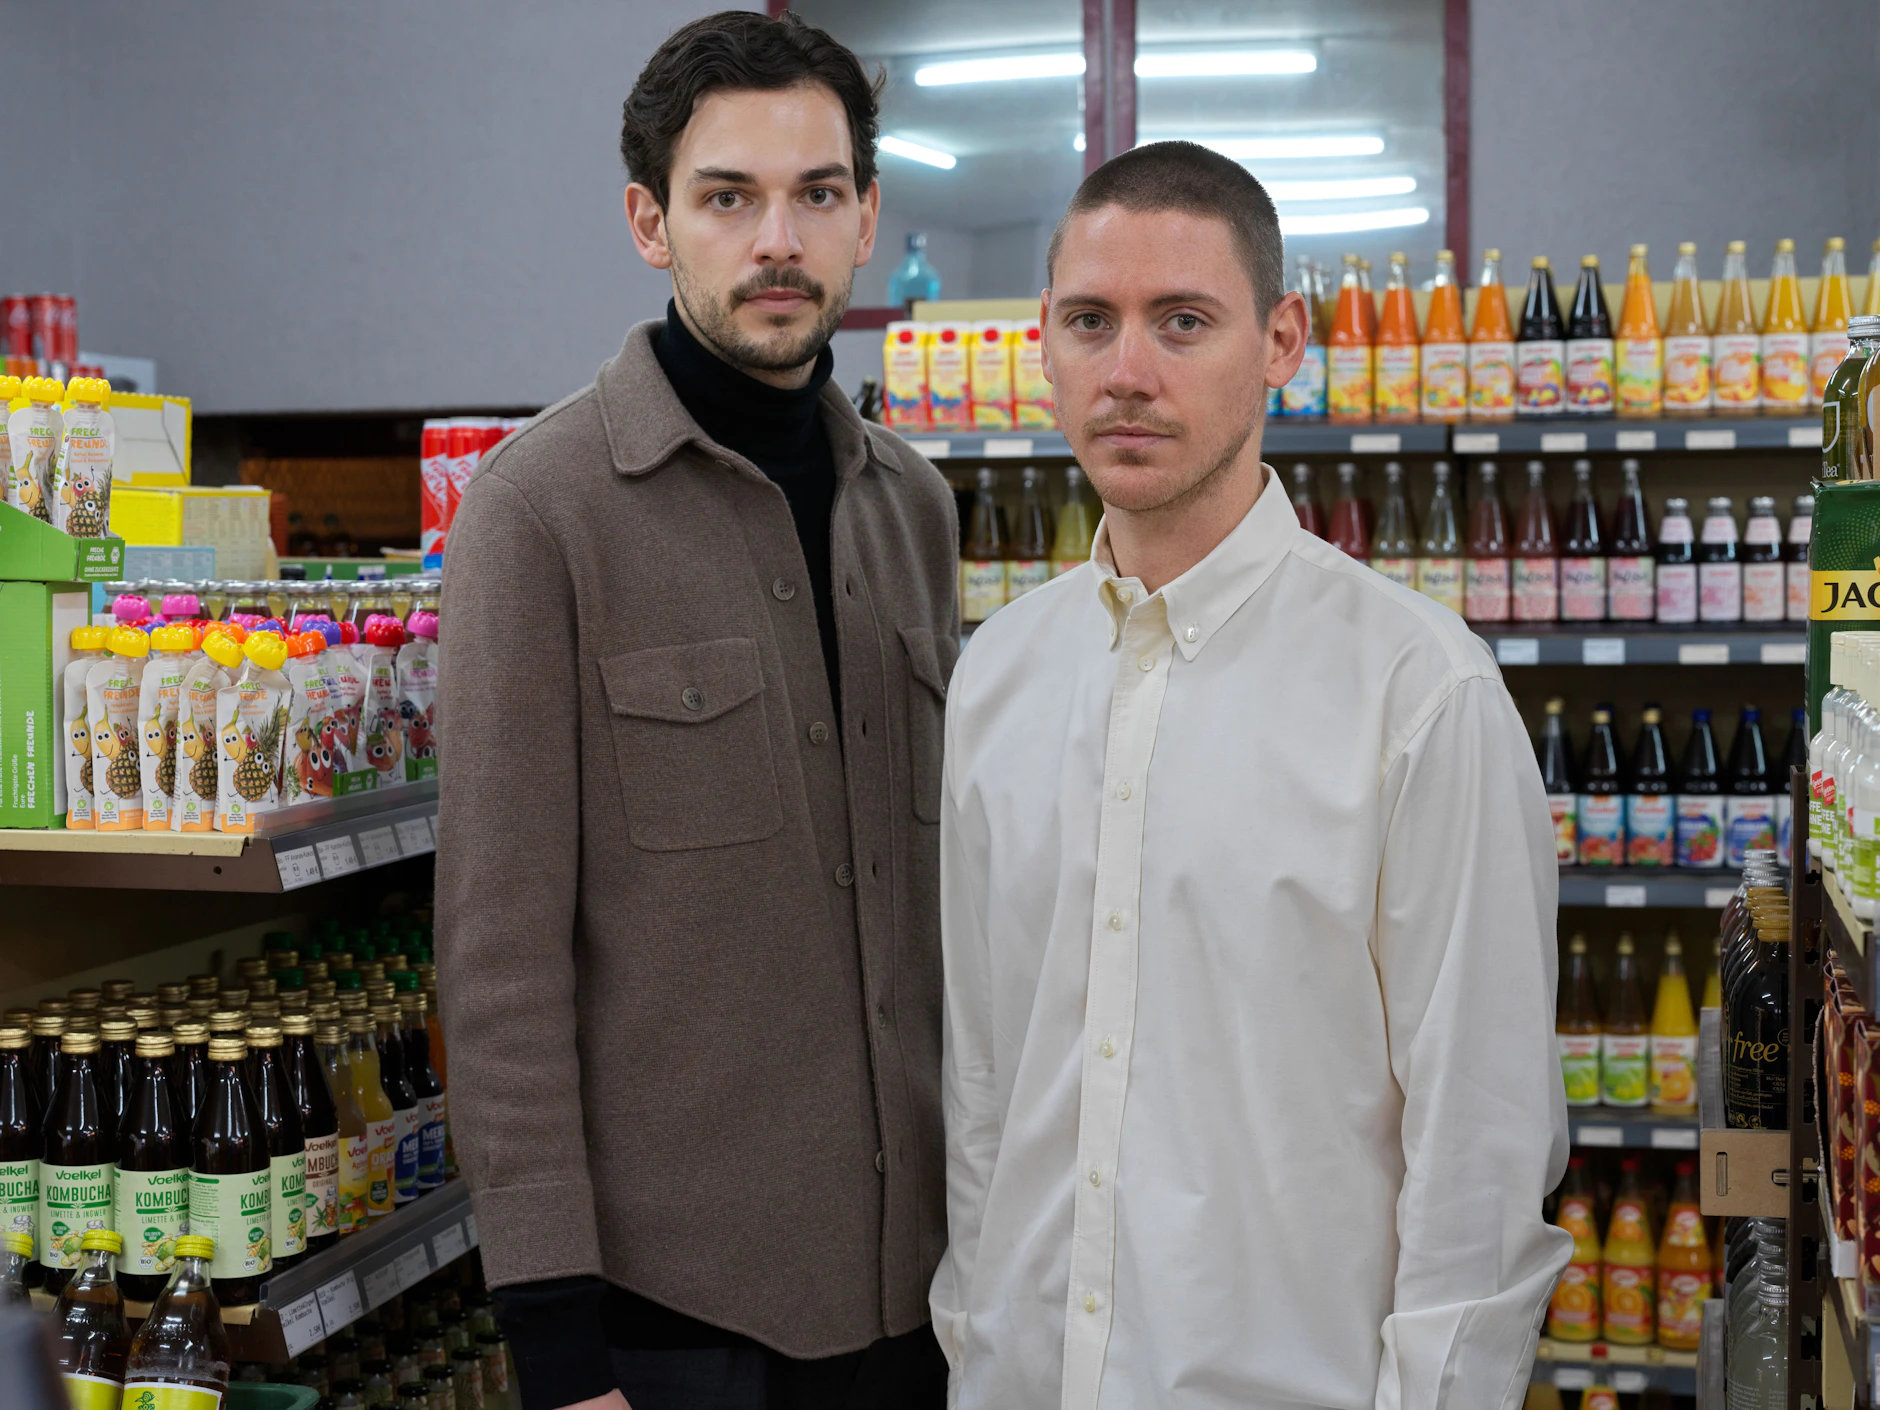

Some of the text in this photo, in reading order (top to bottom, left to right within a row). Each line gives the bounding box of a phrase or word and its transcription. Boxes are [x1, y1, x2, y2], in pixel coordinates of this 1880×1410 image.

[71, 439, 108, 449] REUND
[26, 709, 36, 809] FRECHEN FREUNDE
[1733, 1031, 1779, 1063] free
[56, 1169, 101, 1181] Voelkel
[46, 1184, 111, 1202] KOMBUCHA
[135, 1188, 189, 1208] KOMBUC
[10, 1203, 34, 1214] INGWER
[51, 1208, 107, 1219] LIMETTE & INGWER
[142, 1216, 167, 1225] LIMETTE
